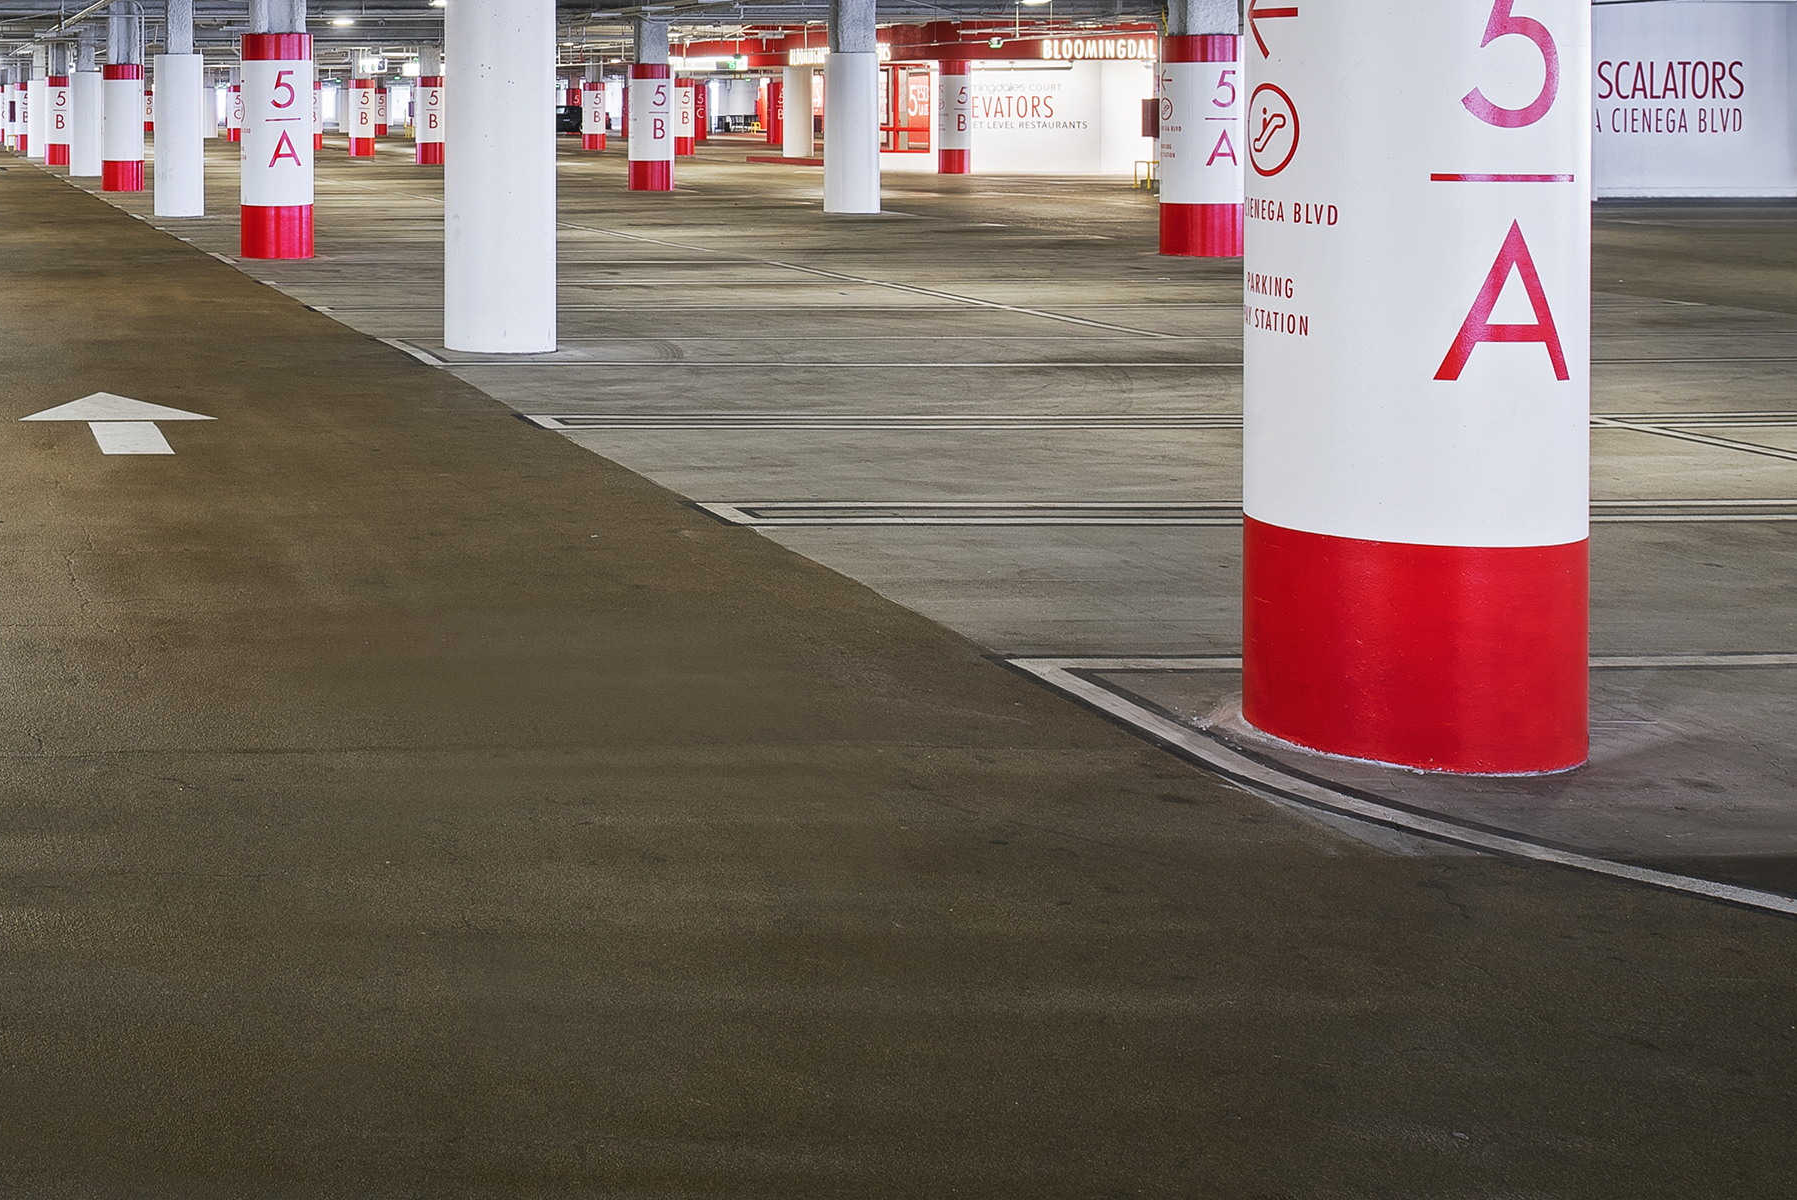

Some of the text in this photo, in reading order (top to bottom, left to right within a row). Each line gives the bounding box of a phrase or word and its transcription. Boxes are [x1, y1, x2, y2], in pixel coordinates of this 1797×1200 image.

[1029, 83, 1062, 92] COURT
[1212, 69, 1236, 108] 5
[1597, 61, 1745, 100] SCALATORS
[270, 70, 295, 109] 5
[652, 84, 667, 106] 5
[681, 90, 691, 105] 5
[956, 86, 968, 105] 5
[55, 90, 66, 107] 5
[146, 97, 152, 105] 5
[235, 94, 241, 105] 5
[360, 91, 370, 105] 5
[378, 95, 385, 105] 5
[428, 90, 439, 106] 5
[573, 95, 580, 104] 5
[593, 92, 602, 105] 5
[696, 93, 704, 104] 5
[908, 84, 918, 117] 5
[146, 107, 152, 115] D
[233, 109, 241, 120] C
[377, 108, 385, 117] C
[696, 107, 705, 119] C
[971, 95, 1054, 119] EVATORS
[55, 113, 65, 130] B
[360, 111, 369, 125] B
[429, 113, 439, 129] B
[593, 110, 601, 123] B
[681, 111, 690, 125] B
[956, 113, 968, 132] B
[1611, 108, 1689, 134] CIENEGA
[1699, 108, 1743, 133] BLVD
[653, 118, 666, 140] B
[987, 121, 1015, 129] LEVEL
[1018, 121, 1088, 130] RESTAURANTS
[268, 129, 302, 168] A
[1205, 128, 1238, 167] A
[1293, 202, 1339, 226] BLVD
[1247, 271, 1294, 299] PARKING
[1432, 218, 1571, 381] A
[1255, 308, 1309, 336] STATION
